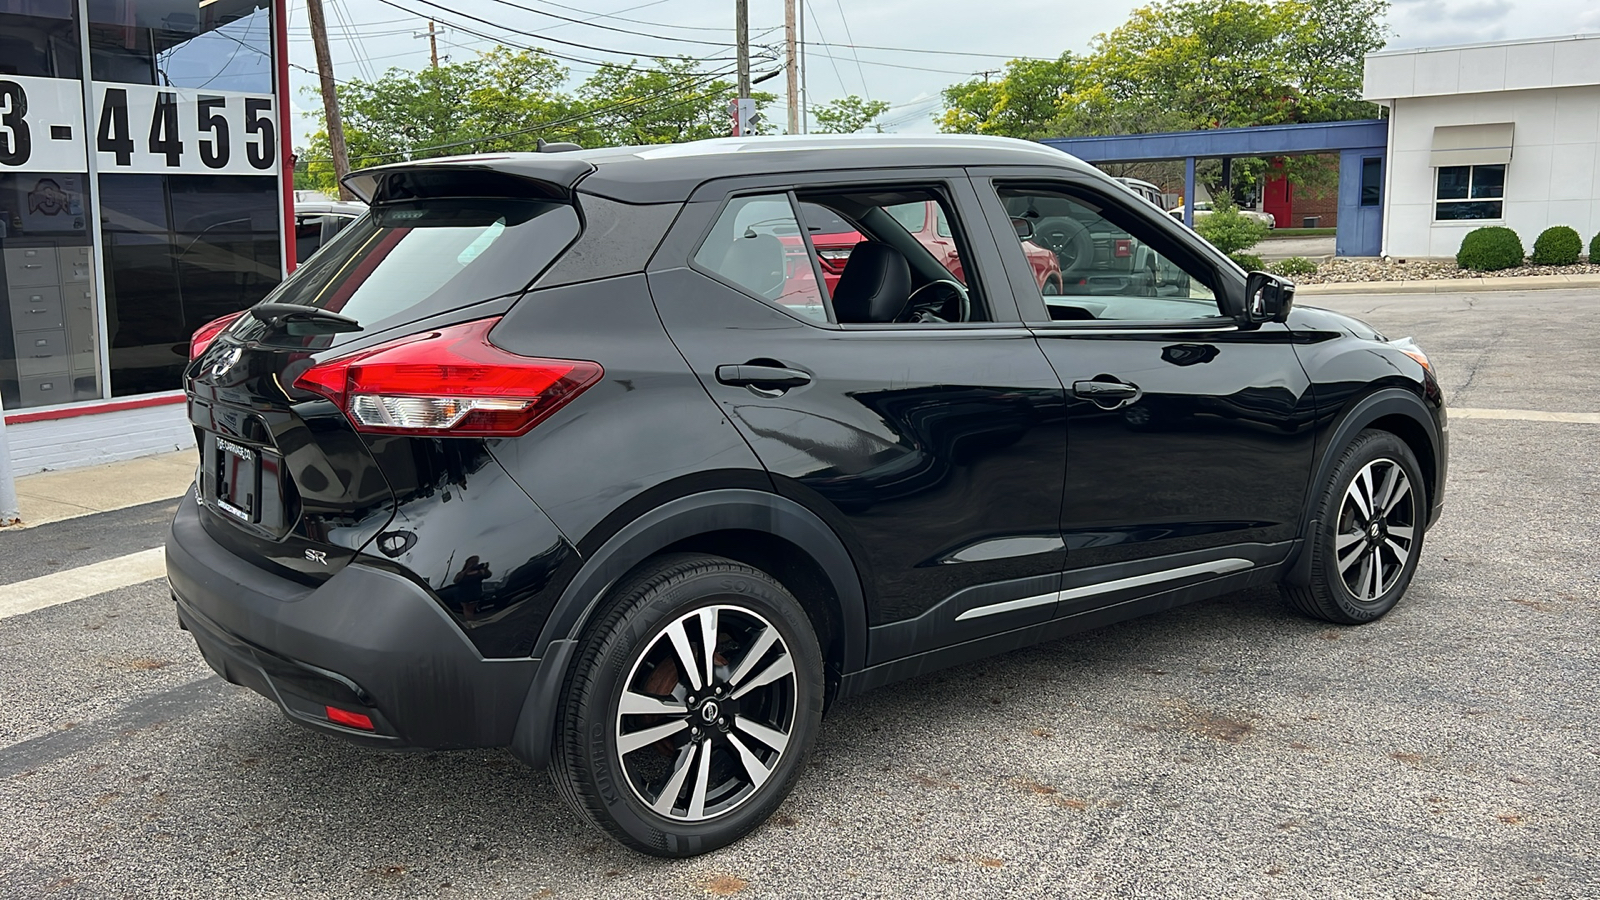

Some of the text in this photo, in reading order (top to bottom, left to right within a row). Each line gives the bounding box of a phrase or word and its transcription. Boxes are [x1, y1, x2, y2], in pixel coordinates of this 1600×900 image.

[304, 548, 328, 566] SR
[720, 579, 784, 605] SOLUS
[1343, 602, 1375, 619] SOLUS
[591, 722, 619, 807] KUMHO
